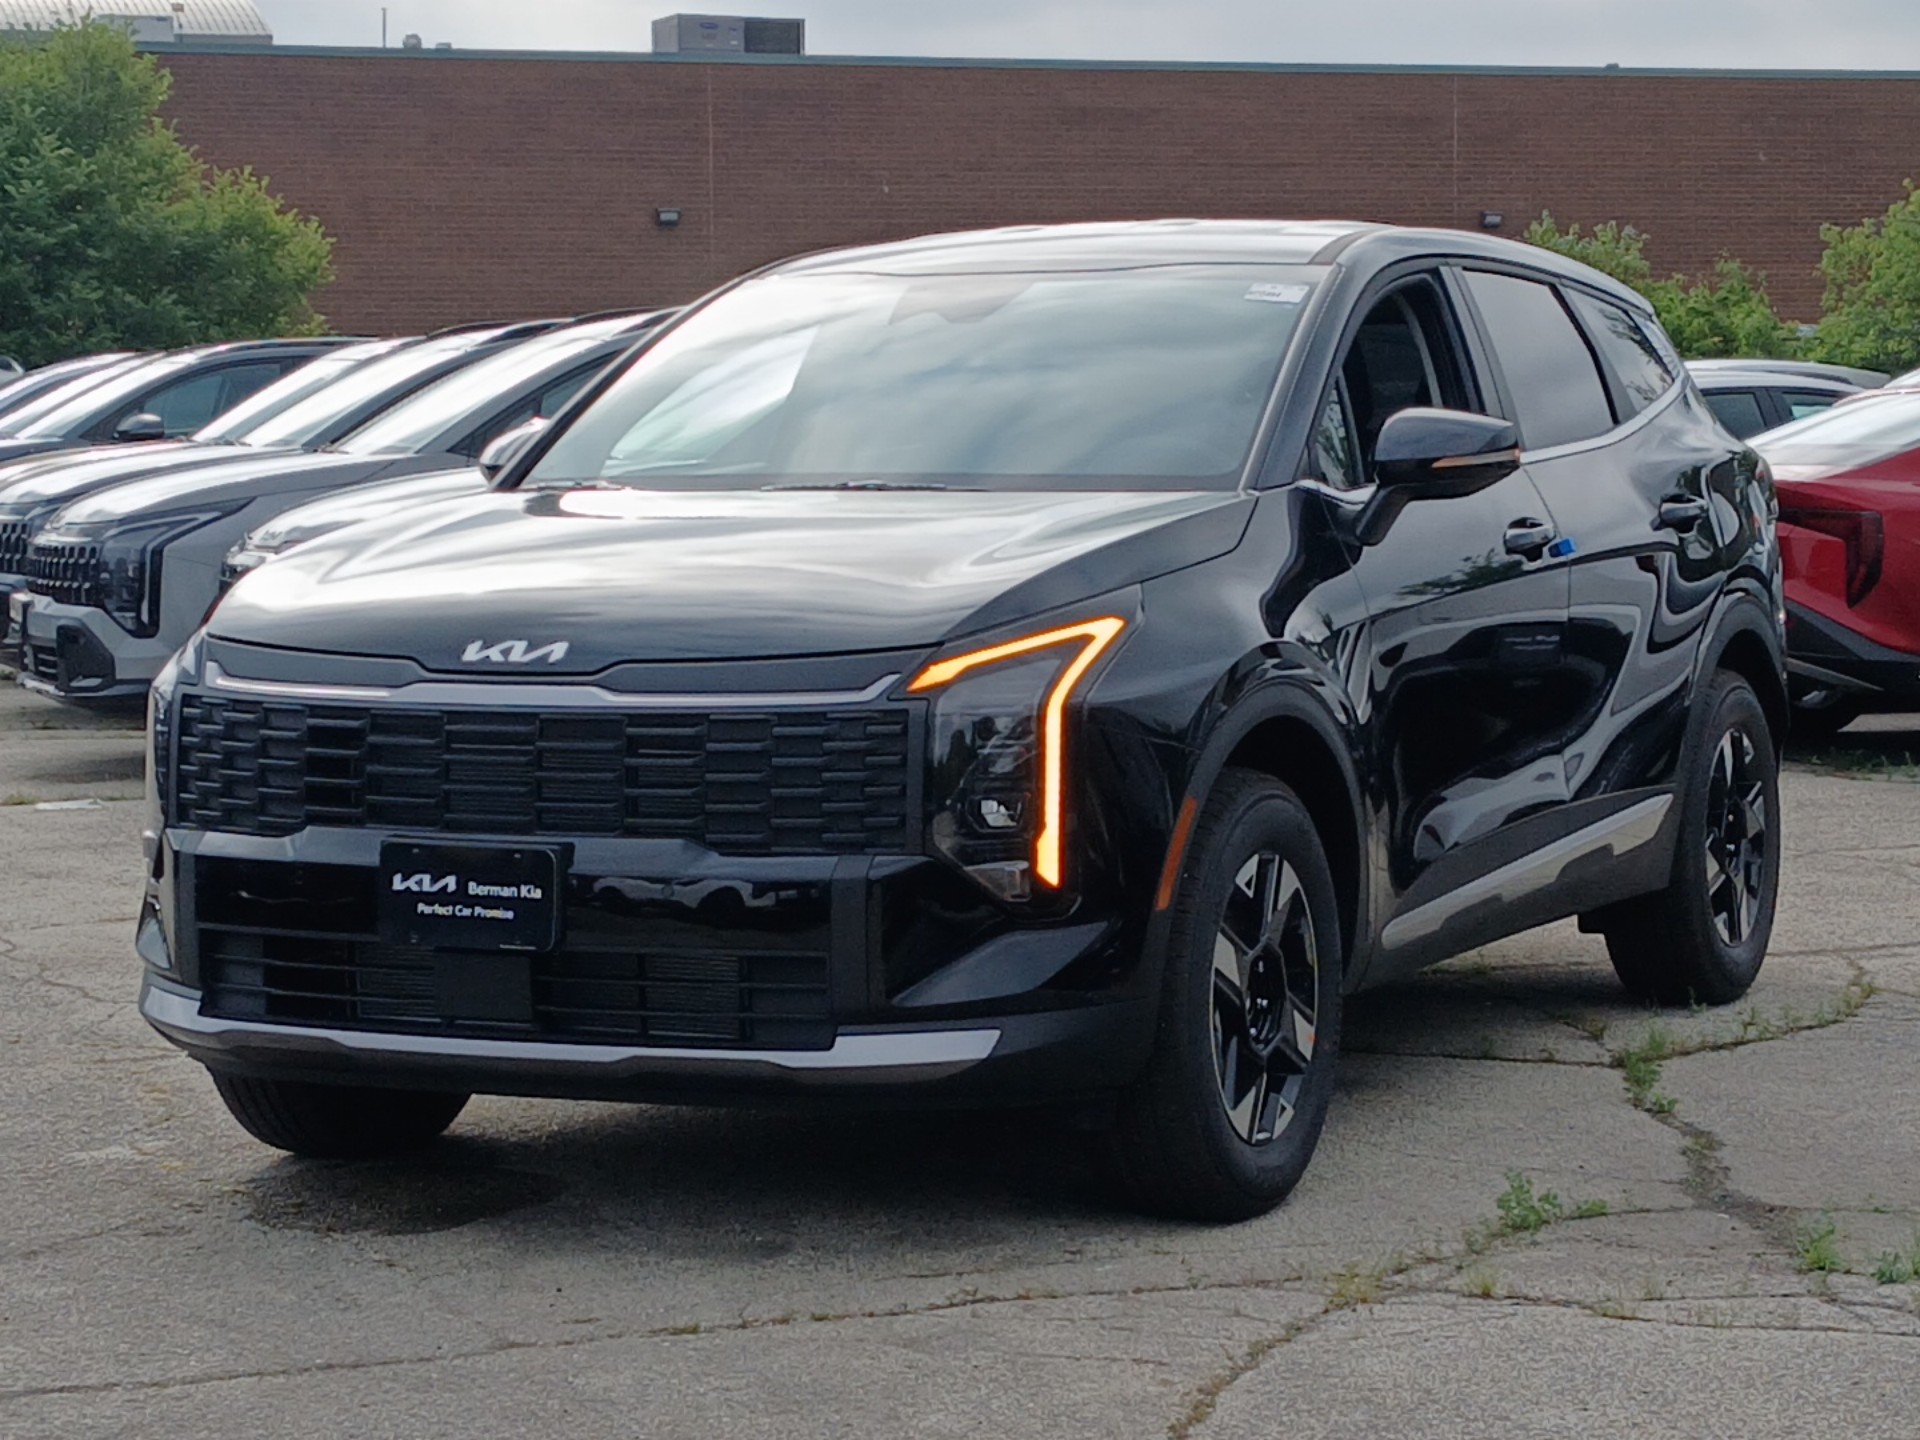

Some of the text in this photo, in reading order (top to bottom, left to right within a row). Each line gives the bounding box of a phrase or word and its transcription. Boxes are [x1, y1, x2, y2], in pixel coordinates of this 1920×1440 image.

[461, 639, 570, 664] KIA
[391, 872, 457, 893] KIA
[467, 881, 542, 900] Berman Kia
[416, 902, 515, 920] Perfect Car Promise
